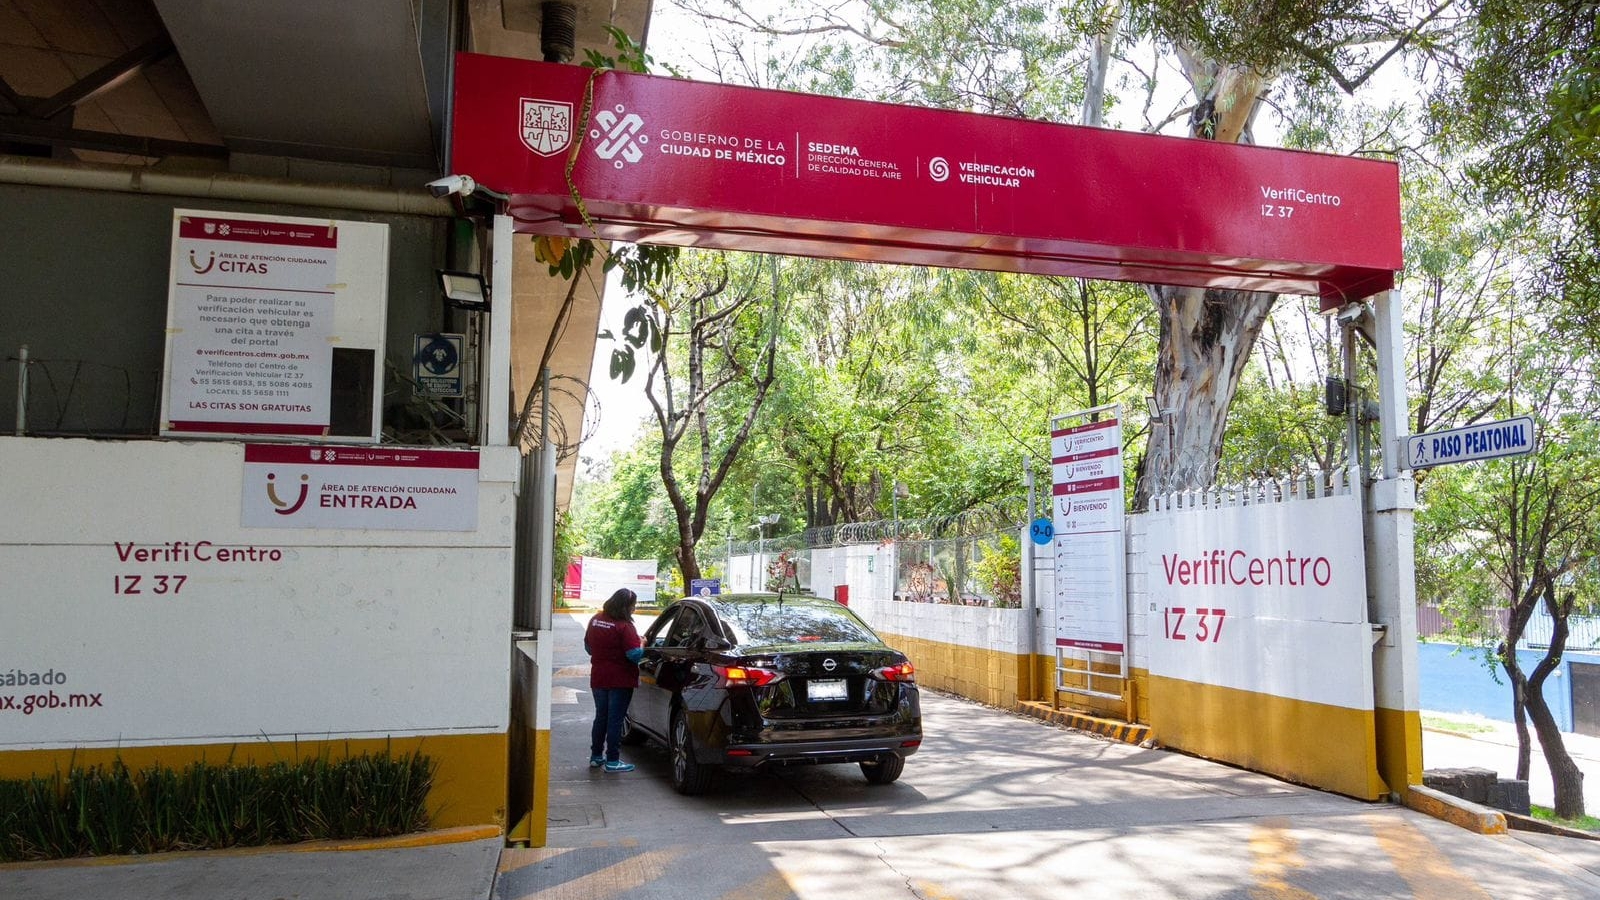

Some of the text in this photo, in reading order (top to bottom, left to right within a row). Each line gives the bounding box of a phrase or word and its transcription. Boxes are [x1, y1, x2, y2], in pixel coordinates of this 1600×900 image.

[660, 130, 785, 151] GOBIERNO DE LA
[660, 144, 786, 166] CIUDAD DE MÉXICO
[808, 142, 859, 156] SEDEMA
[808, 153, 898, 170] DIRECCIÓN GENERAL
[808, 164, 902, 180] DE CALIDAD DEL AIRE
[959, 162, 1035, 178] VERIFICACIÓN
[959, 174, 1020, 188] VEHICULAR
[1260, 186, 1341, 206] VerifiCentro
[1261, 204, 1294, 218] IZ 37
[251, 254, 286, 262] ATENCIÓN
[219, 260, 268, 274] CITAS
[206, 294, 227, 302] Para
[230, 296, 256, 304] poder
[258, 298, 292, 306] realizar
[197, 305, 254, 314] verificación
[257, 306, 300, 316] vehicular
[200, 315, 310, 328] necesario que obtenga
[264, 328, 294, 337] través
[248, 338, 278, 346] portal
[196, 368, 242, 376] Verificación
[208, 360, 242, 368] Teléfono
[260, 362, 286, 370] Centro
[210, 402, 236, 410] CITAS
[262, 404, 312, 412] GRATUITAS
[1074, 436, 1104, 446] VERIFICENTRO
[1433, 424, 1526, 459] PASO PEATONAL
[321, 483, 346, 492] ÁREA
[362, 484, 406, 494] ATENCIÓN
[408, 486, 457, 494] CIUDADANA
[320, 494, 417, 510] ENTRADA
[1074, 502, 1108, 512] BIENVENIDO
[1032, 525, 1052, 538] 9-0
[114, 540, 282, 563] VerifiCentro
[1162, 550, 1331, 586] VerifiCentro
[114, 575, 188, 594] IZ 37
[1164, 607, 1226, 642] IZ 37
[0, 668, 67, 686] sábado
